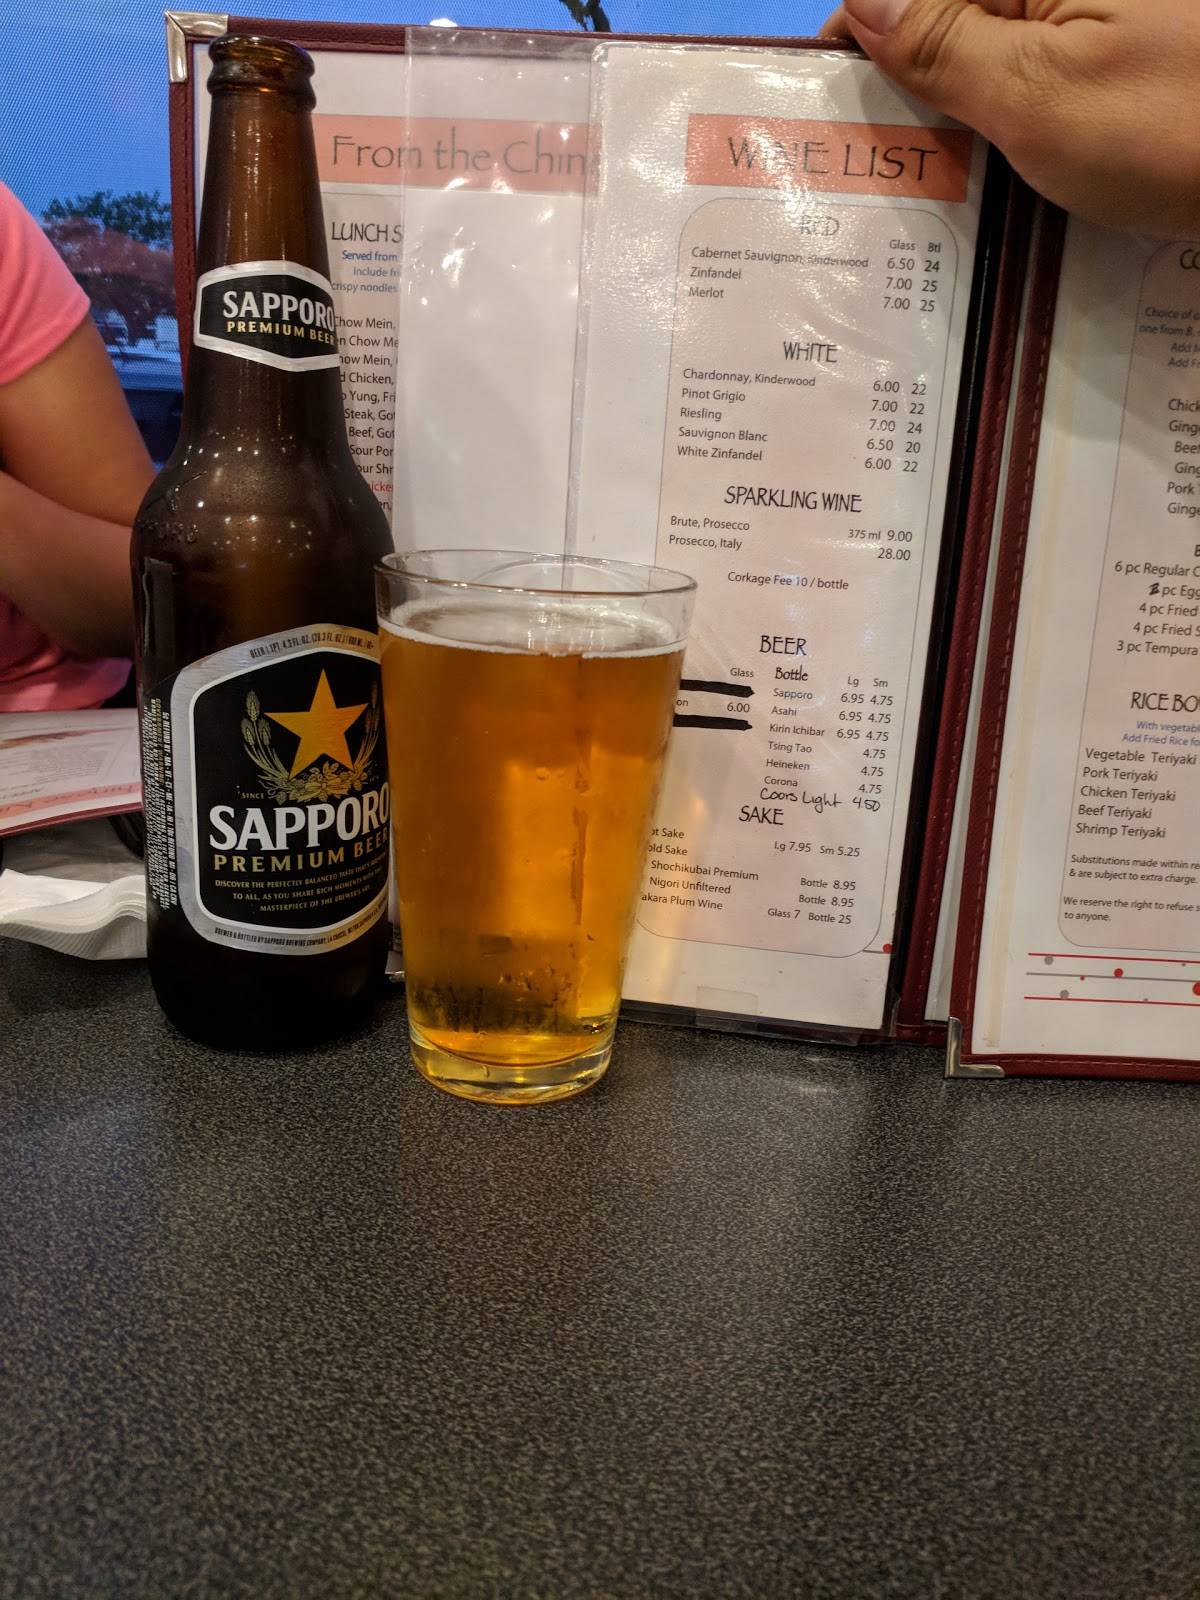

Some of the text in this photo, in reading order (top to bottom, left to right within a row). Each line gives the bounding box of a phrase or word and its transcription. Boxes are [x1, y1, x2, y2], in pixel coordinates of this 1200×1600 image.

[332, 135, 422, 169] From
[434, 126, 492, 172] the
[843, 143, 938, 182] LIST
[331, 222, 388, 242] LUNCH
[889, 239, 942, 253] Glass Btl
[342, 250, 397, 262] Served from
[692, 247, 741, 261] Cabernet
[887, 258, 915, 272] 6.50
[924, 260, 940, 273] 24
[353, 267, 388, 277] Include
[690, 267, 938, 293] Zinfandel 7.00 25
[332, 282, 398, 294] crispy noodles
[689, 287, 935, 313] Merlot 7.00 25
[223, 291, 335, 331] SAPPORO
[227, 321, 305, 338] PREMIUM
[349, 335, 380, 347] Chow
[363, 354, 392, 367] Mein,
[783, 341, 838, 363] WHITE
[349, 372, 394, 385] Chicken,
[683, 368, 927, 395] Chardonnay, Kinderwood 6.00 22
[349, 391, 380, 405] Yung,
[681, 388, 925, 415] Pinot Grigio 7.00 22
[344, 408, 375, 421] Steak,
[680, 407, 922, 434] Riesling 7.00 24
[349, 426, 374, 439] Beef,
[679, 427, 921, 453] Sauvignon Blanc 6.50 20
[350, 445, 373, 456] Sour
[677, 446, 918, 472] White Zinfandel 6.00 22
[1167, 481, 1194, 495] Pork
[724, 486, 862, 513] SPARKLING WINE
[670, 516, 913, 543] Brute, Prosecco 375 ml 9.00
[669, 535, 911, 562] Prosecco, Italy 28.00
[1115, 561, 1190, 577] 6 pc Regular
[727, 572, 849, 590] Corkage Fee 10 bottle
[1139, 603, 1198, 617] 4 pc Fried
[1133, 622, 1192, 636] 4 pc Fried
[759, 635, 807, 656] BEER
[1117, 640, 1198, 657] 3 pc Tempura
[730, 665, 888, 688] Glass Bottle Lg Sm
[773, 688, 894, 706] Sapporo 6.95 4.75
[1130, 691, 1169, 711] RICE
[727, 702, 750, 713] 6.00
[771, 705, 891, 724] Asahi 6.95 4.75
[769, 724, 791, 735] Kirin
[836, 728, 861, 740] 6.95
[865, 730, 889, 742] 4.75
[768, 741, 886, 760] Tsing Tao 4.75
[1085, 748, 1197, 765] Vegetable Teriyaki
[766, 759, 884, 777] Heineken 4.75
[1083, 766, 1158, 783] Pork Teriyaki
[764, 776, 882, 794] Corona 4.75
[1080, 785, 1177, 802] Chicken Teriyaki
[760, 787, 798, 802] Coors
[802, 791, 842, 814] Light
[209, 782, 390, 851] SAPPORO
[738, 805, 784, 826] SAKE
[1078, 804, 1152, 820] Beef Teriyaki
[662, 828, 685, 839] Sake
[1076, 823, 1167, 839] Shrimp Teriyaki
[665, 841, 860, 857] Sake Lg 7.95 Sm 5.25
[214, 847, 345, 873] PREMIUM
[215, 879, 250, 888] DISCOVER
[252, 881, 265, 889] THE
[651, 860, 856, 891] Shochikubai Premium Bottle 8.95
[650, 877, 854, 907] Nigori Unfiltered Bottle 8.95
[670, 895, 852, 924] Plum Wine Glass 7 Bottle 25
[1064, 897, 1152, 911] We reserve right
